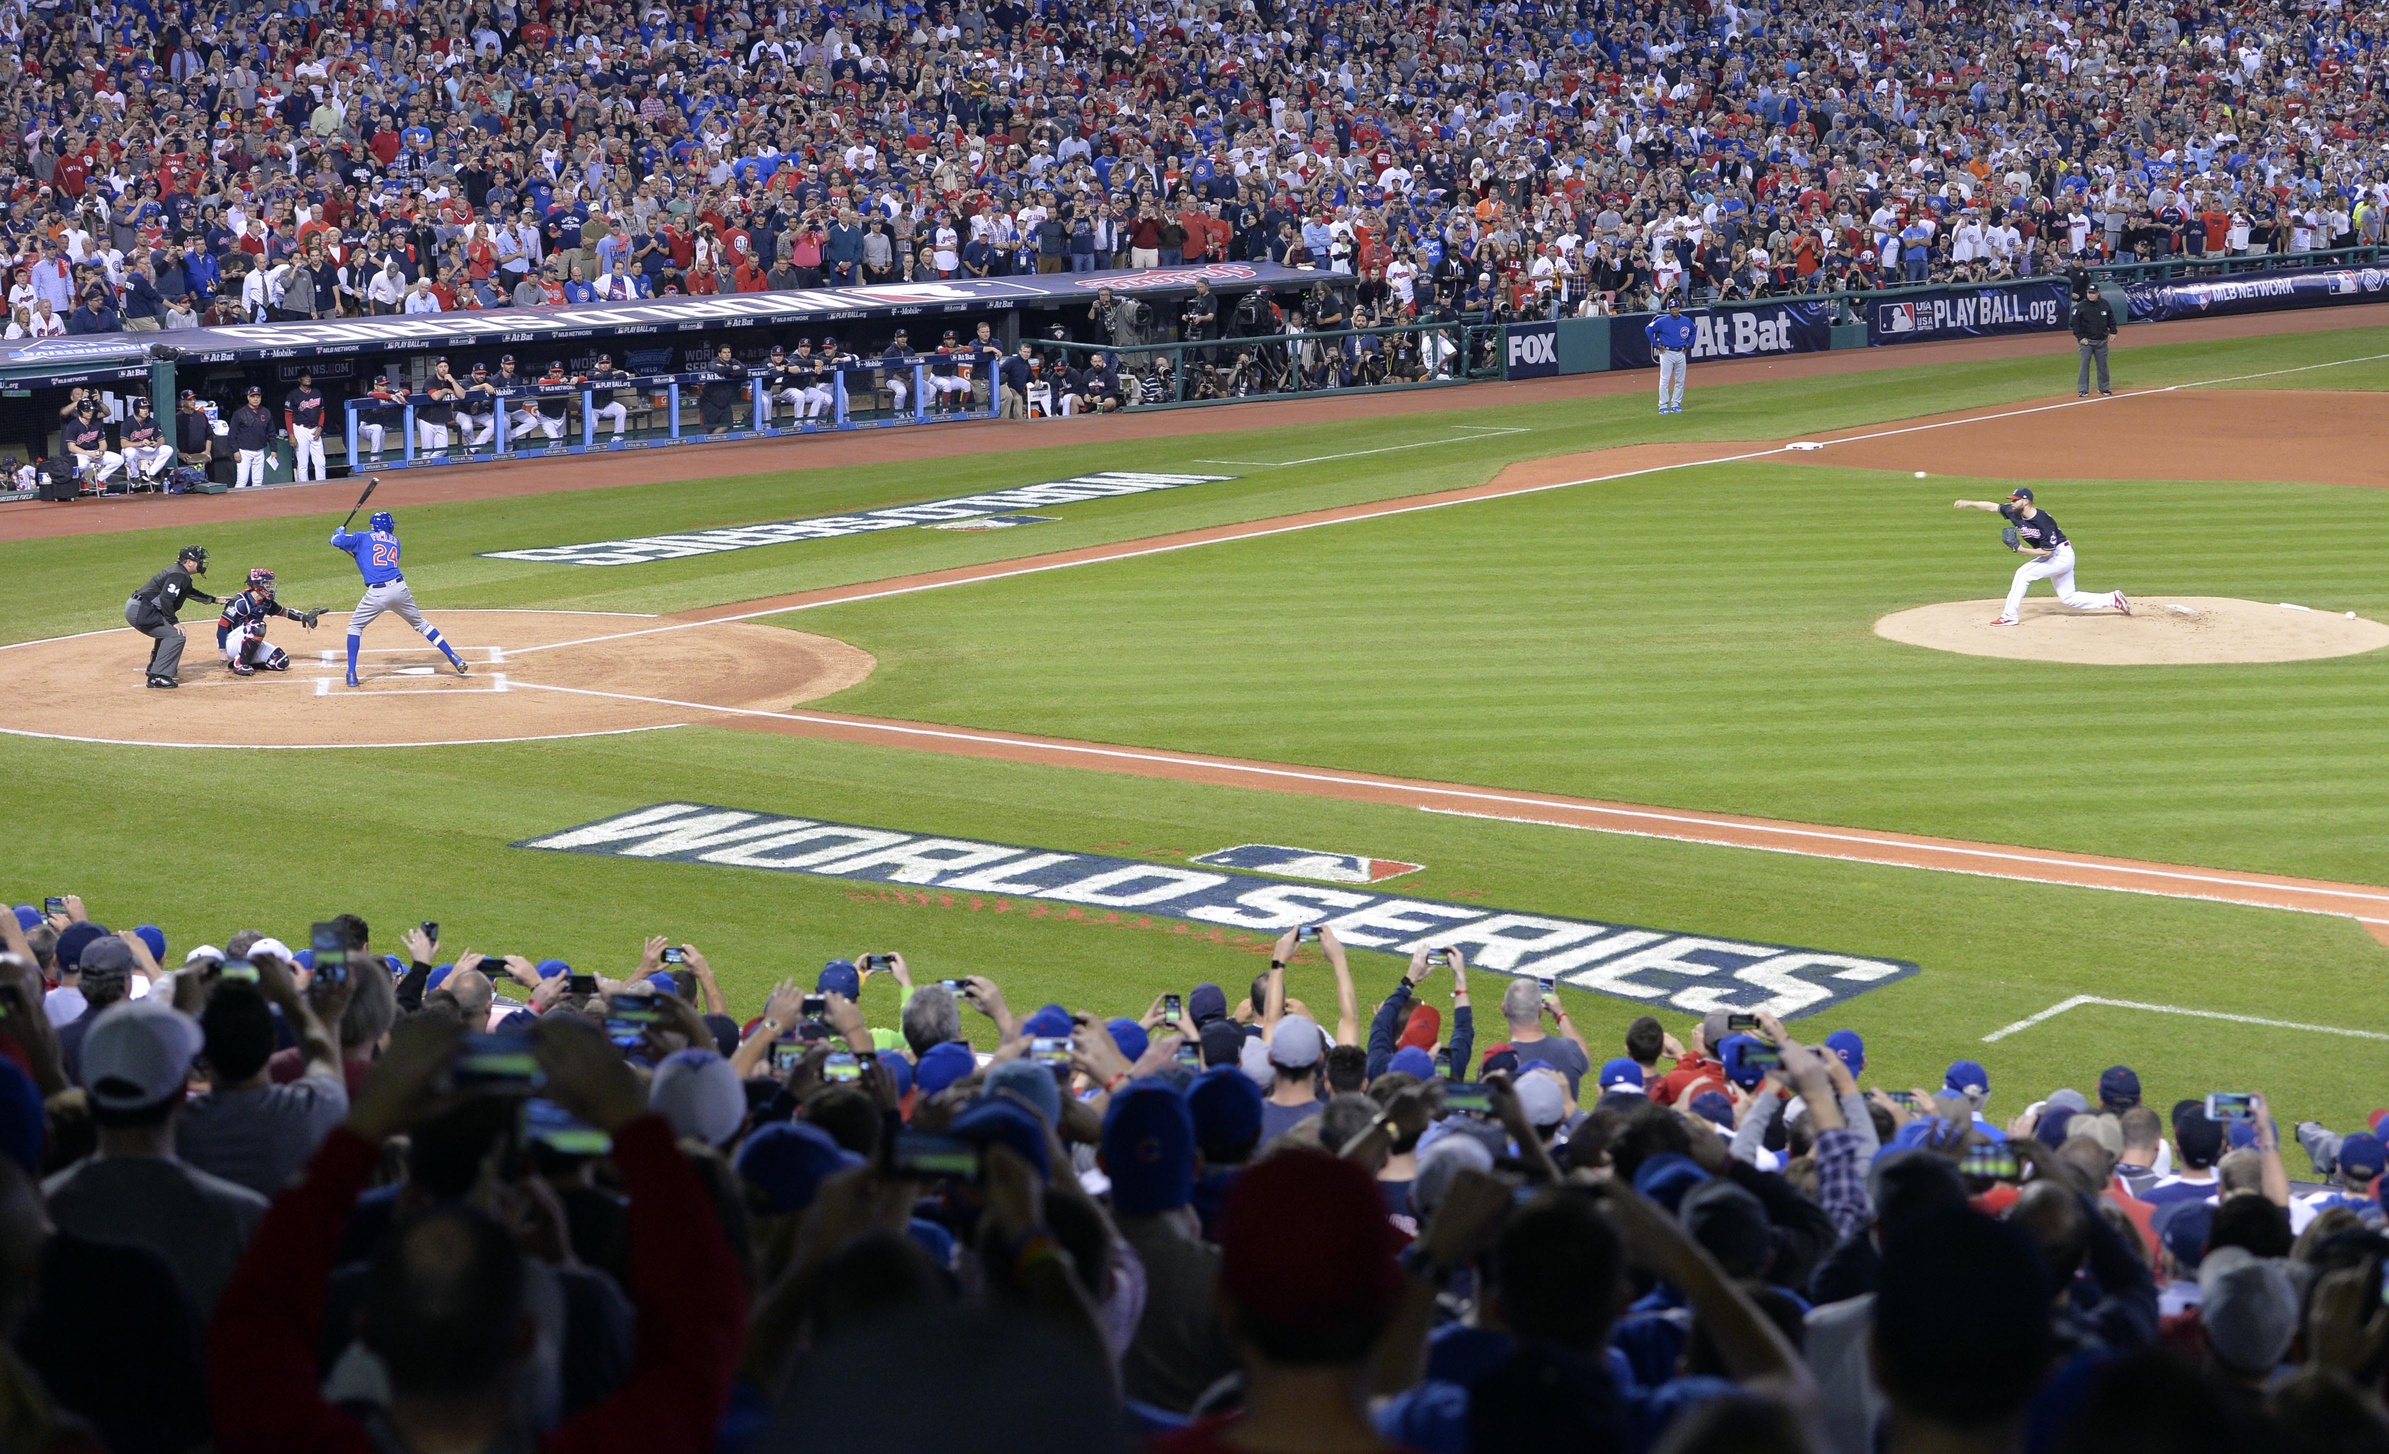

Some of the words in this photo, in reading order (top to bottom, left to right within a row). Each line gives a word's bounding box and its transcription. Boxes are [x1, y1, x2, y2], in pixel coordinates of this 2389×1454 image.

[2213, 287, 2237, 302] MLB
[2239, 279, 2294, 299] NETWORK
[1934, 297, 1977, 329] PLAY
[1980, 294, 2057, 325] BALL.org
[1508, 332, 1557, 366] FOX
[1691, 316, 1728, 358] At
[1734, 312, 1791, 353] Bat
[284, 363, 349, 377] INDNS.OM
[373, 544, 398, 568] 24
[167, 583, 180, 597] 34
[526, 803, 1227, 906] WORLD
[1187, 886, 1902, 1018] SERIES
